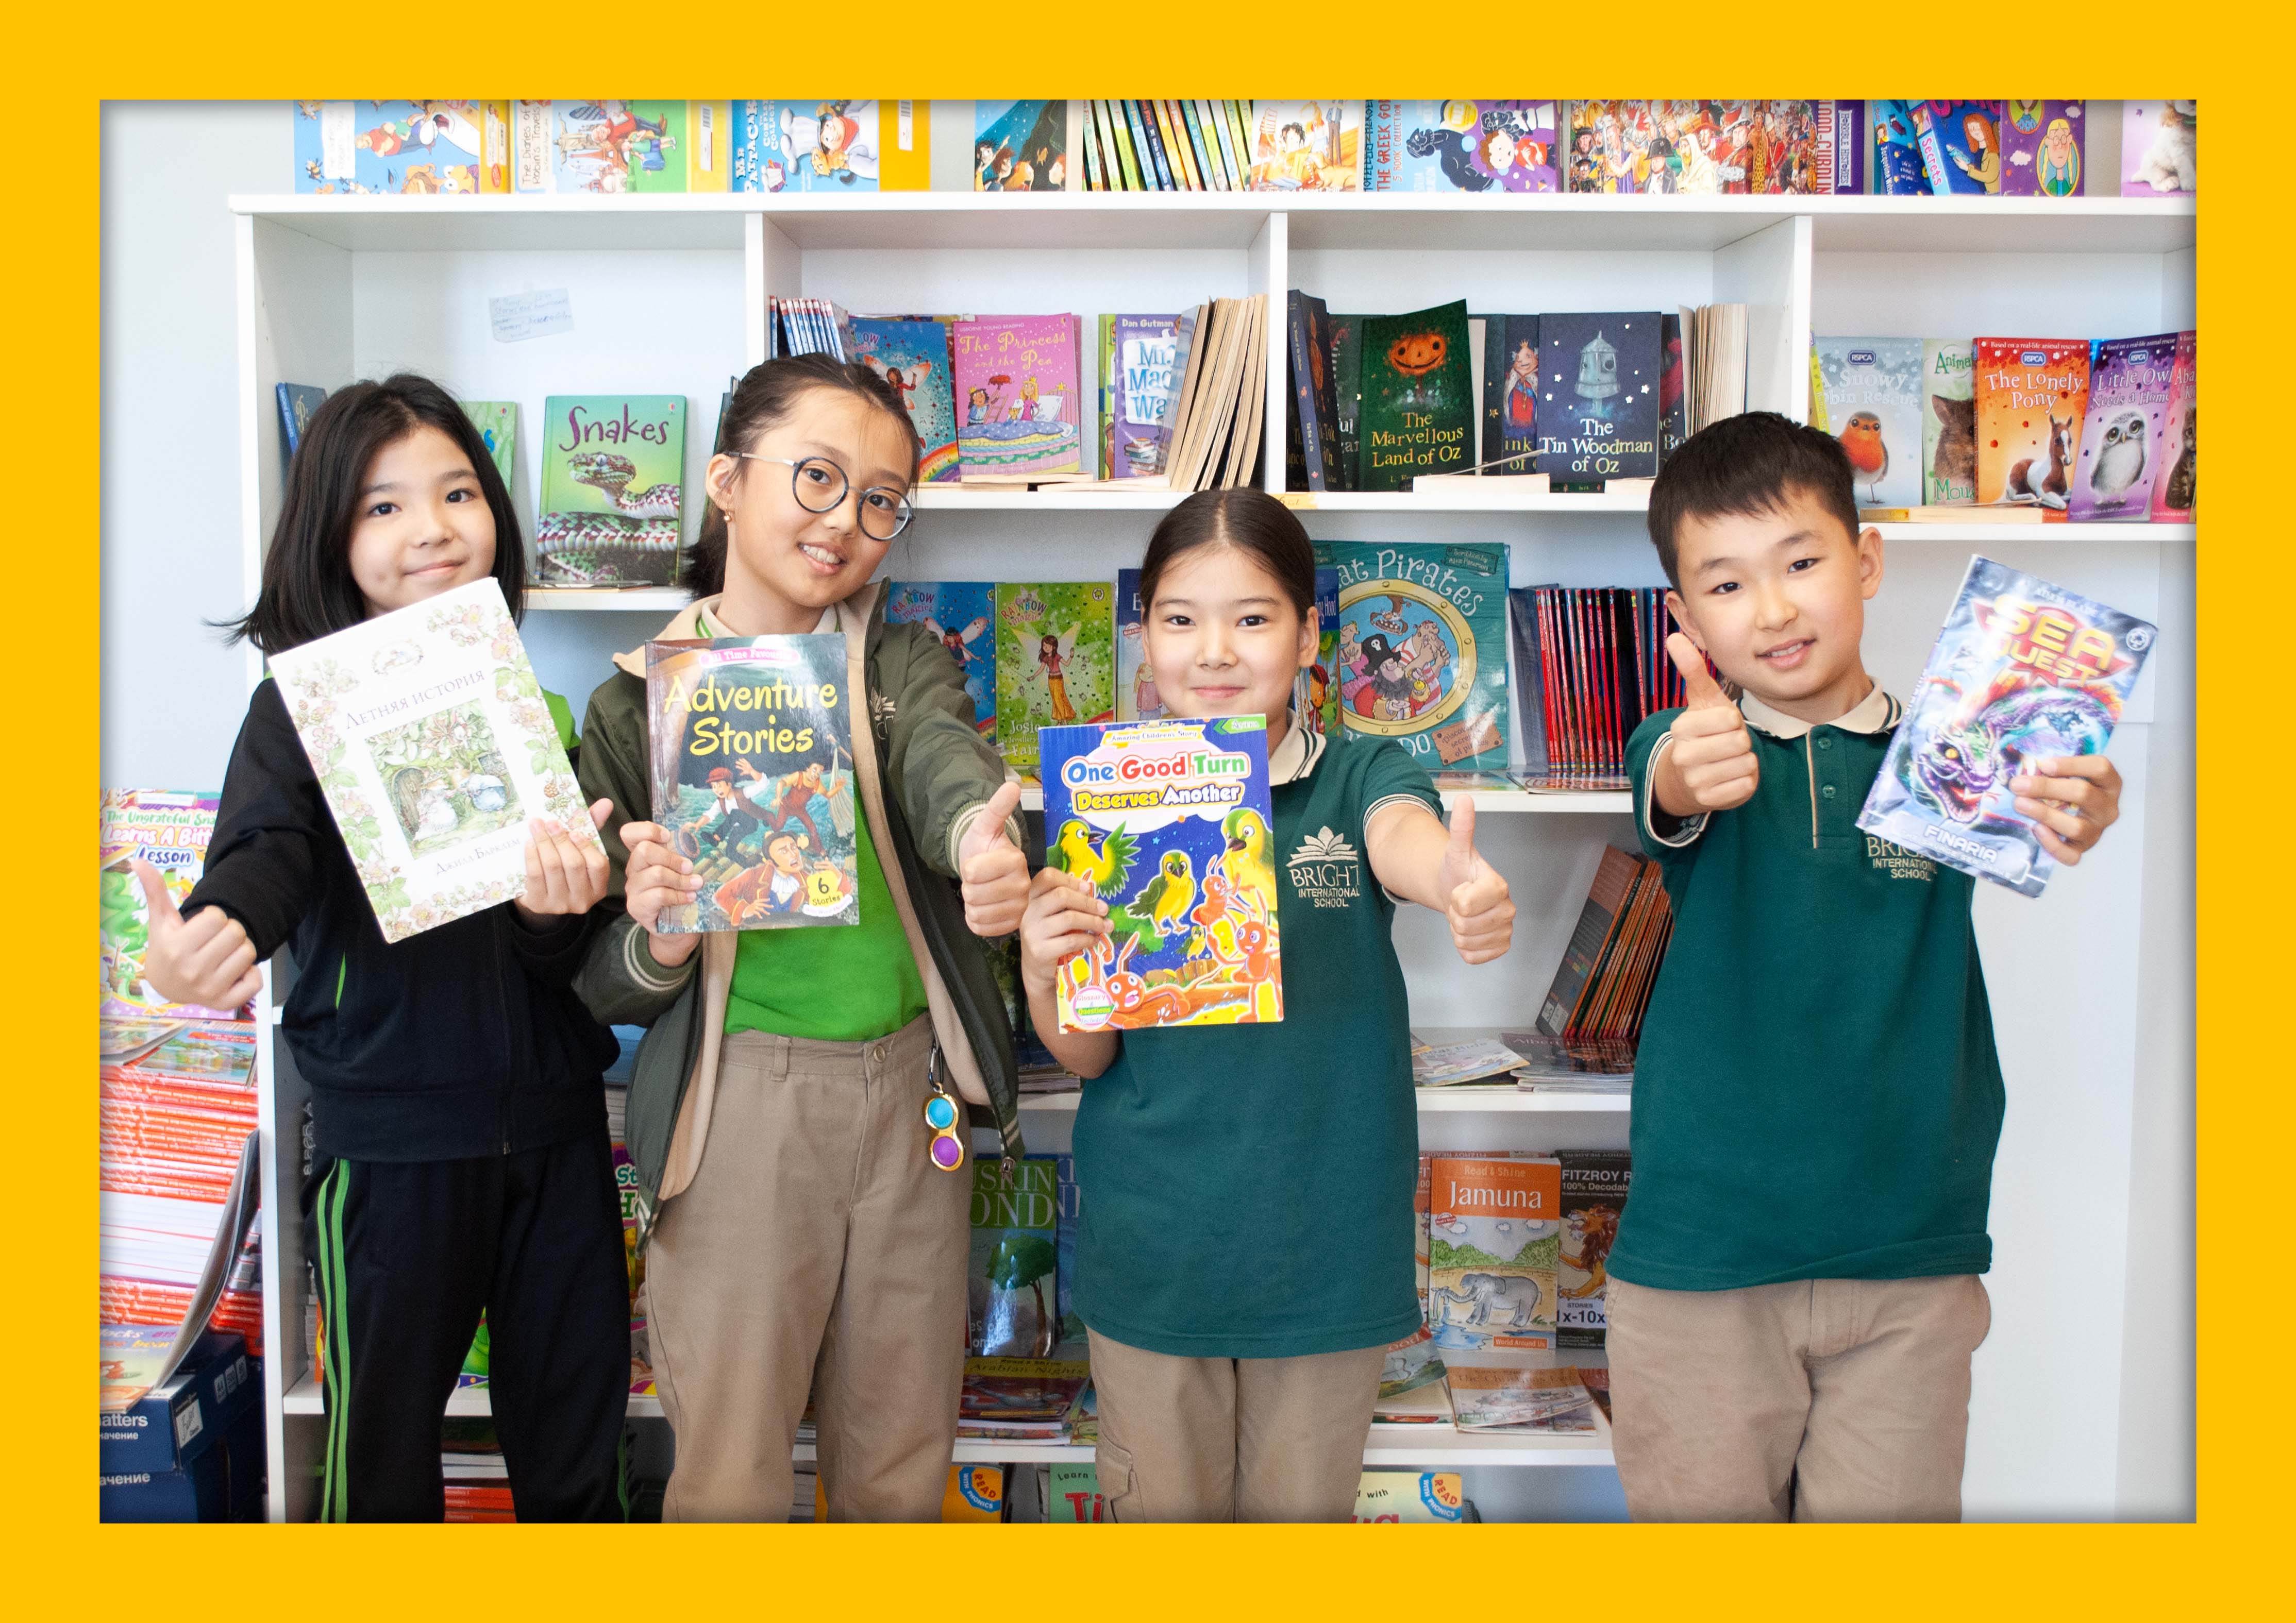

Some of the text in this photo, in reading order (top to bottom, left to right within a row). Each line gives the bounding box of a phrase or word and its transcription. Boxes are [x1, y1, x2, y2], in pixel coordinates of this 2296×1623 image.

[1393, 104, 1402, 147] COLLECTION
[521, 107, 531, 185] The Diaries of
[531, 107, 541, 185] Robin's Travels
[1377, 124, 1391, 192] THE GREEK
[1393, 149, 1402, 171] BOOK
[1920, 138, 1943, 186] Secrets
[1121, 318, 1174, 328] Dan Gutman
[959, 330, 1066, 354] The Princess
[974, 348, 1052, 371] and the Pea
[1839, 369, 1908, 391] Snowy
[1985, 370, 2084, 394] The Lonely
[2097, 365, 2174, 392] Little Owl
[1863, 390, 1919, 408] Rescue
[2012, 391, 2058, 414] Pony
[2090, 393, 2136, 410] Needs a
[559, 403, 671, 452] Snakes
[1402, 412, 1433, 429] The
[1580, 418, 1614, 437] The
[1371, 426, 1464, 447] Marvellous
[1539, 436, 1653, 455] Tin Woodman
[1372, 445, 1462, 467] Land of Oz
[1571, 457, 1619, 475] of Oz
[1376, 549, 1484, 616] Pirates
[891, 589, 935, 614] RAINBOW
[1001, 600, 1047, 619] RAINBOW
[1325, 594, 1336, 617] Hood
[1985, 595, 2116, 668] SEA
[724, 651, 748, 661] Time
[1994, 635, 2101, 688] QUEST
[345, 670, 487, 730] ЛЕТНЯЯ ИСТОРИЯ
[663, 674, 839, 713] Adventure
[690, 714, 814, 756] Stories
[1111, 734, 1141, 742] Amazing
[1177, 730, 1197, 738] Story
[1067, 752, 1246, 784] One Good Turn
[1077, 785, 1241, 810] Deserves Another
[106, 810, 124, 822] The
[127, 811, 191, 825] Ungrateful
[103, 826, 157, 844] Learns
[160, 827, 175, 846] A
[1924, 823, 1999, 864] FINARIA
[137, 847, 191, 864] Lesson
[435, 838, 521, 876] ДЖИЛЛ БАРКЛЕМ
[817, 876, 829, 894] 6
[1289, 864, 1360, 887] BRIGHT
[1890, 867, 1932, 882] SCHOOL
[812, 894, 841, 906] Stories
[1298, 887, 1361, 899] INTERNATIONAL
[1314, 898, 1350, 908] SCHOOL
[1464, 1165, 1527, 1178] Read & Shine
[1562, 1170, 1619, 1181] FITZROY
[1450, 1180, 1543, 1209] Jamuna
[99, 1413, 148, 1428] atters
[974, 1473, 997, 1499] READ
[1057, 1472, 1088, 1481] Learn
[967, 1489, 994, 1510] PHONICS
[1367, 1489, 1389, 1499] with
[1434, 1478, 1459, 1506] READ
[1428, 1496, 1456, 1518] PHONICS
